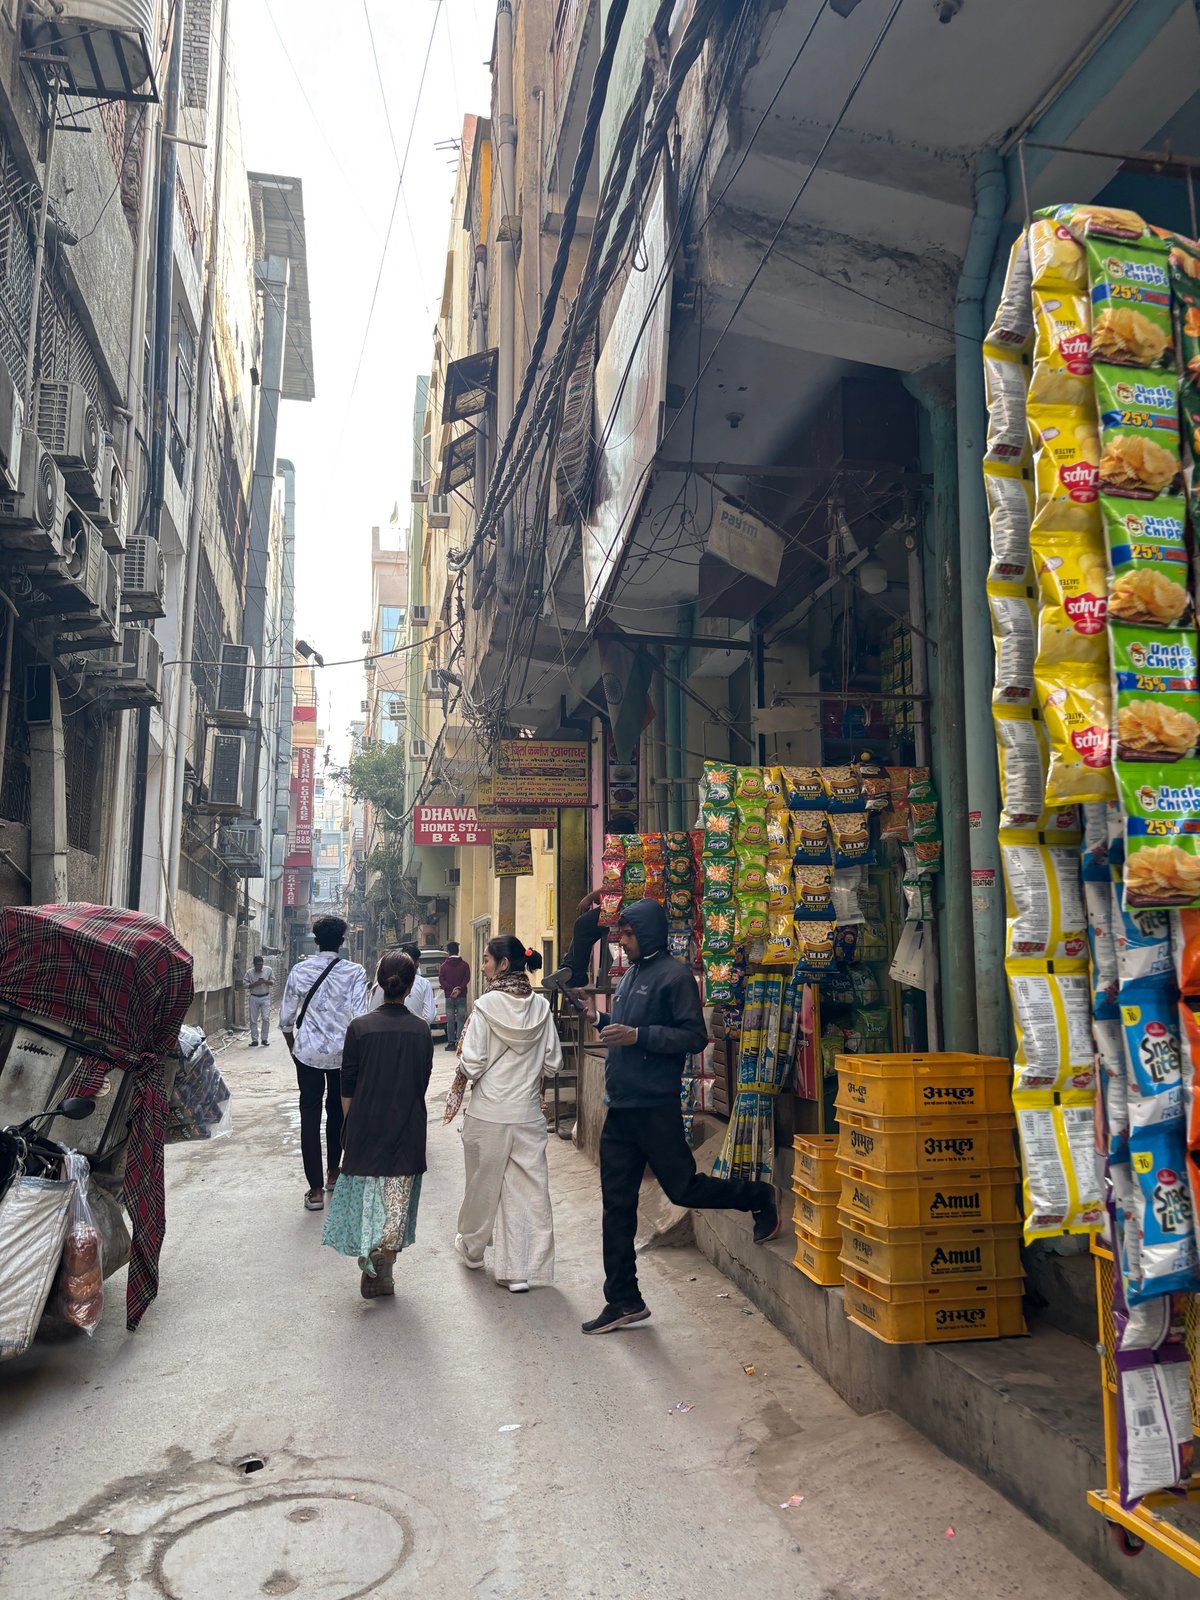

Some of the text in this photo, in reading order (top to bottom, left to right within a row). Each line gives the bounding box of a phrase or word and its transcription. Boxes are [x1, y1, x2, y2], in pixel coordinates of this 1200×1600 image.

[1125, 262, 1165, 275] Uncle
[1110, 285, 1142, 302] 25%
[1136, 384, 1174, 398] Uncle
[1121, 411, 1152, 427] 25%
[1144, 516, 1182, 529] Uncle
[1130, 544, 1162, 561] 25%
[1150, 643, 1190, 656] Uncle
[1136, 674, 1166, 692] 25%
[300, 786, 309, 820] COTTAGE
[420, 823, 455, 832] HOME
[1144, 819, 1180, 836] 25%
[296, 836, 311, 844] B&B
[432, 833, 477, 842] B & B
[768, 935, 792, 946] Chips
[175, 1108, 184, 1120] VIP
[182, 1127, 191, 1138] VIP
[930, 1192, 980, 1212] Amul
[930, 1247, 982, 1268] Amul
